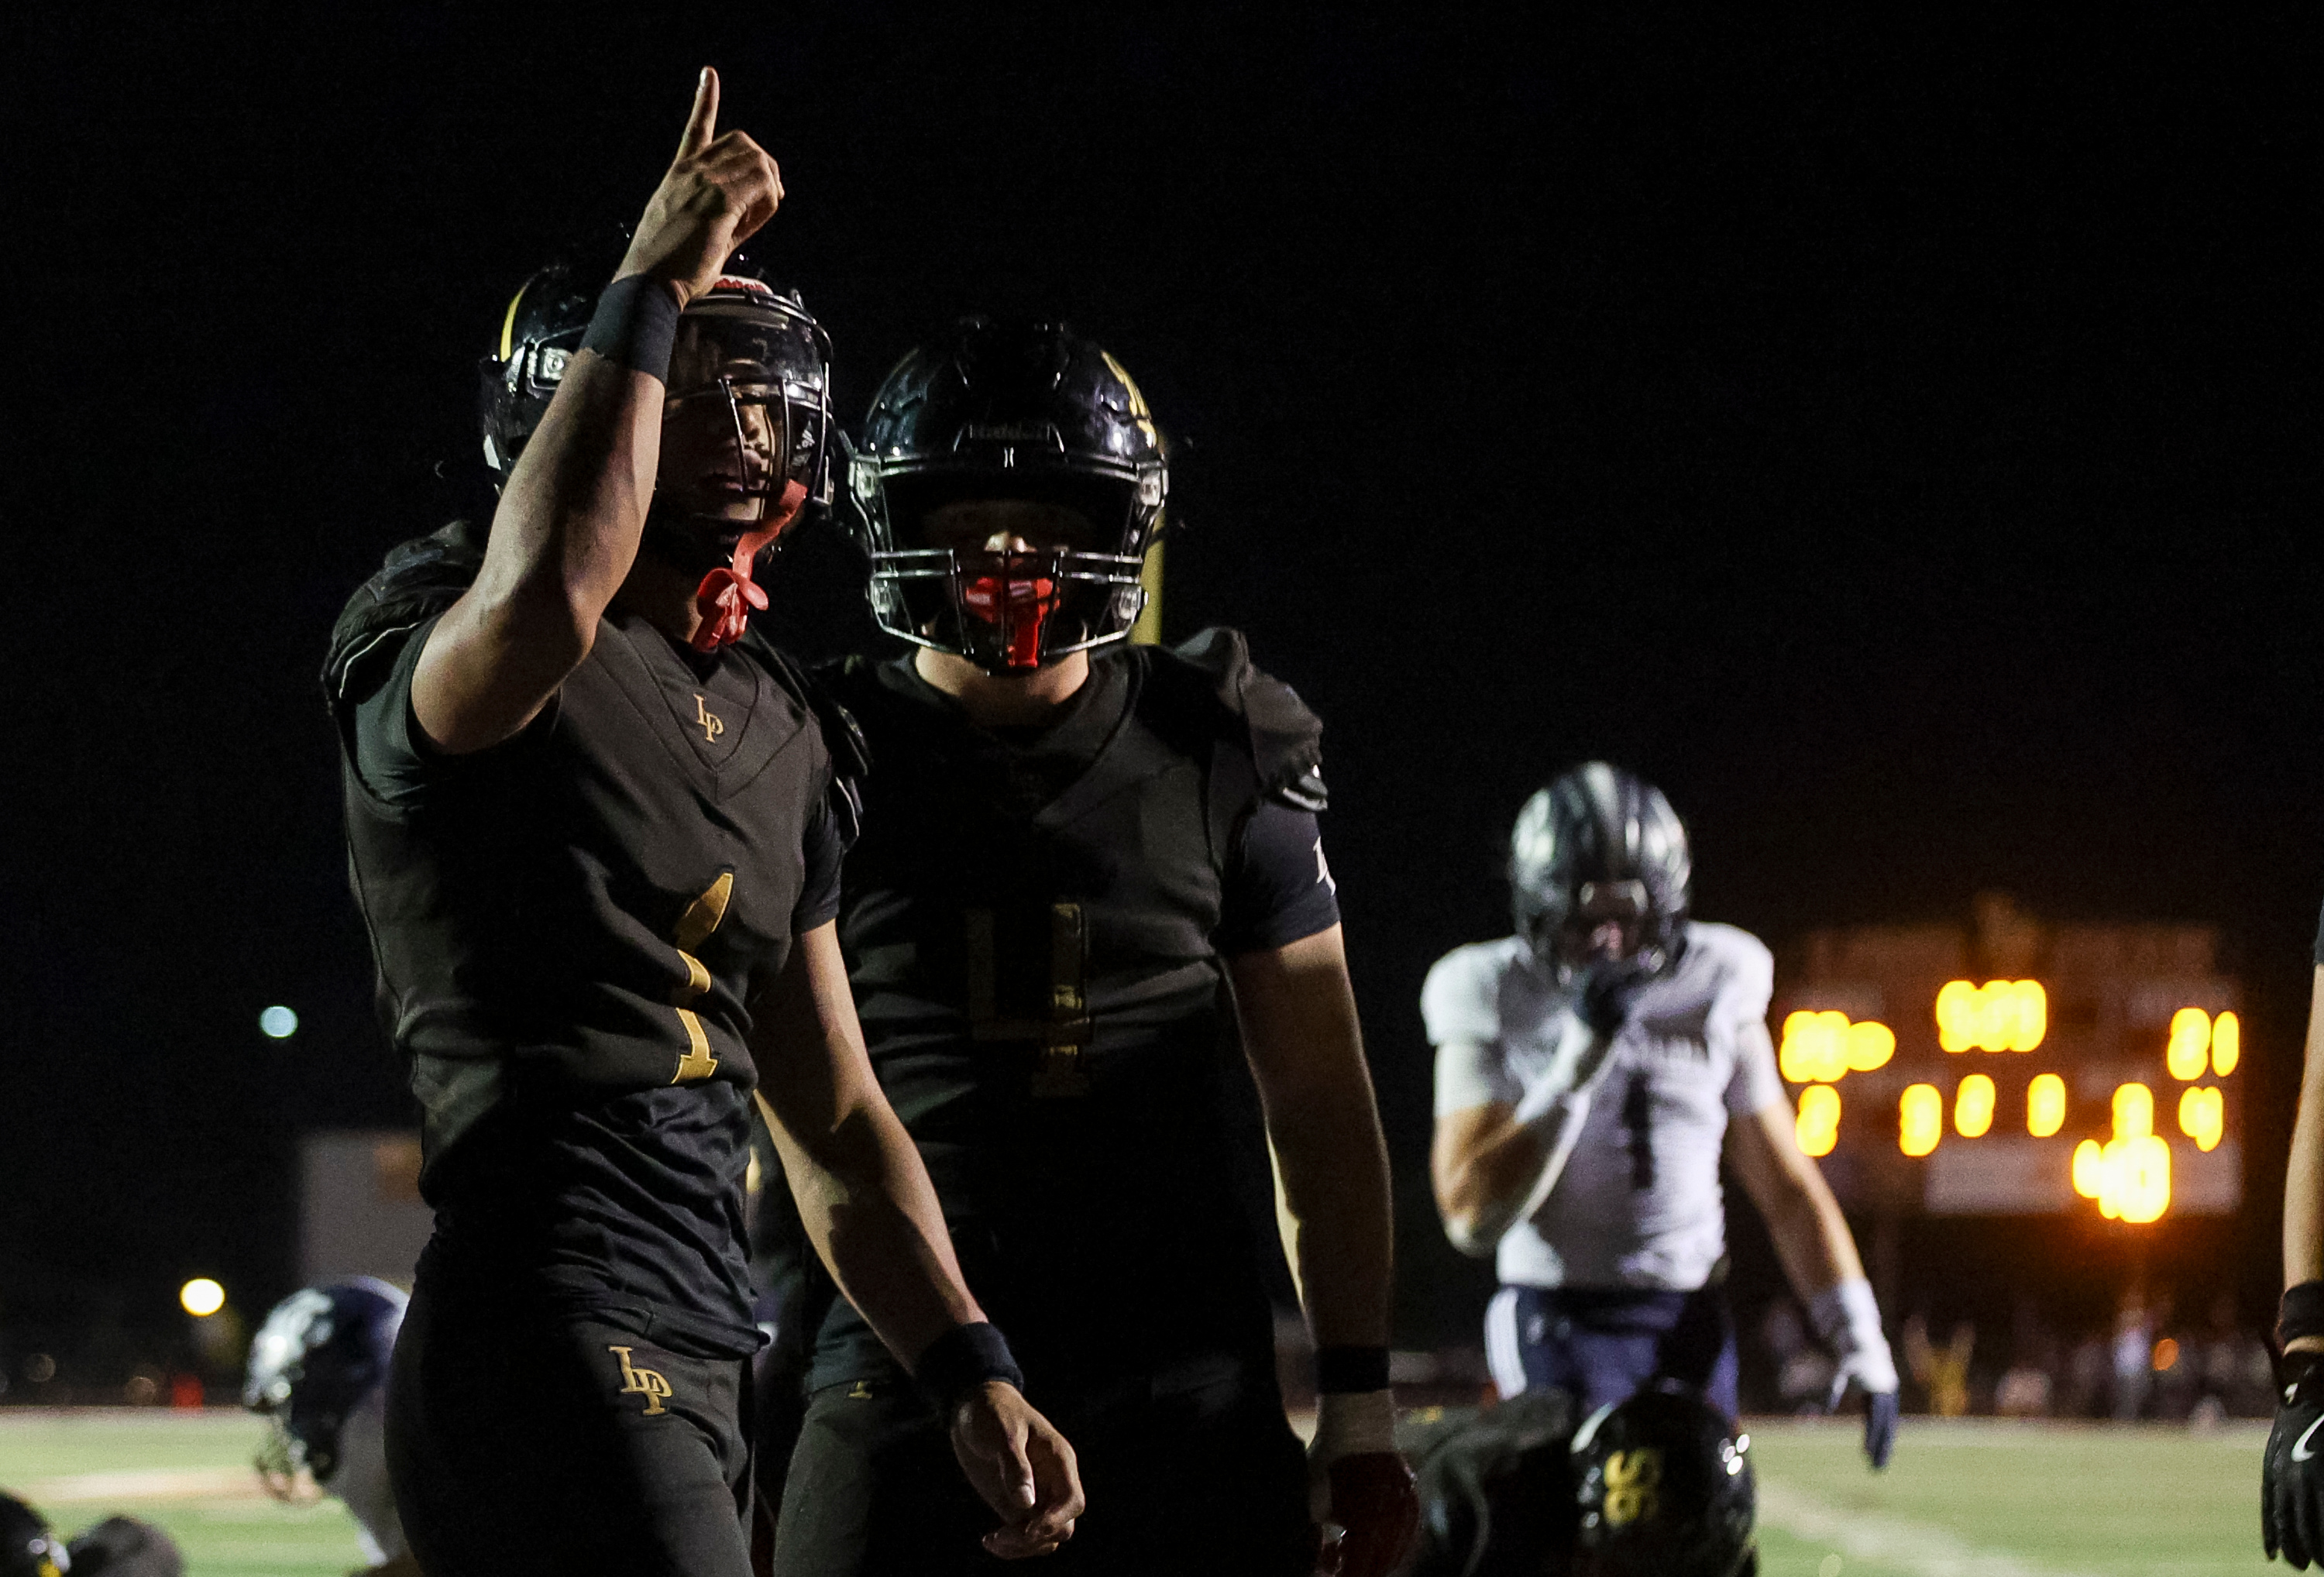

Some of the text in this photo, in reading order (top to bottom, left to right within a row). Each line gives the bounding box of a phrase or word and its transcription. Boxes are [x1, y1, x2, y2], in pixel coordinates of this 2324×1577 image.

[693, 692, 724, 744] LP
[671, 871, 734, 1084] 1
[608, 1346, 672, 1416] LP
